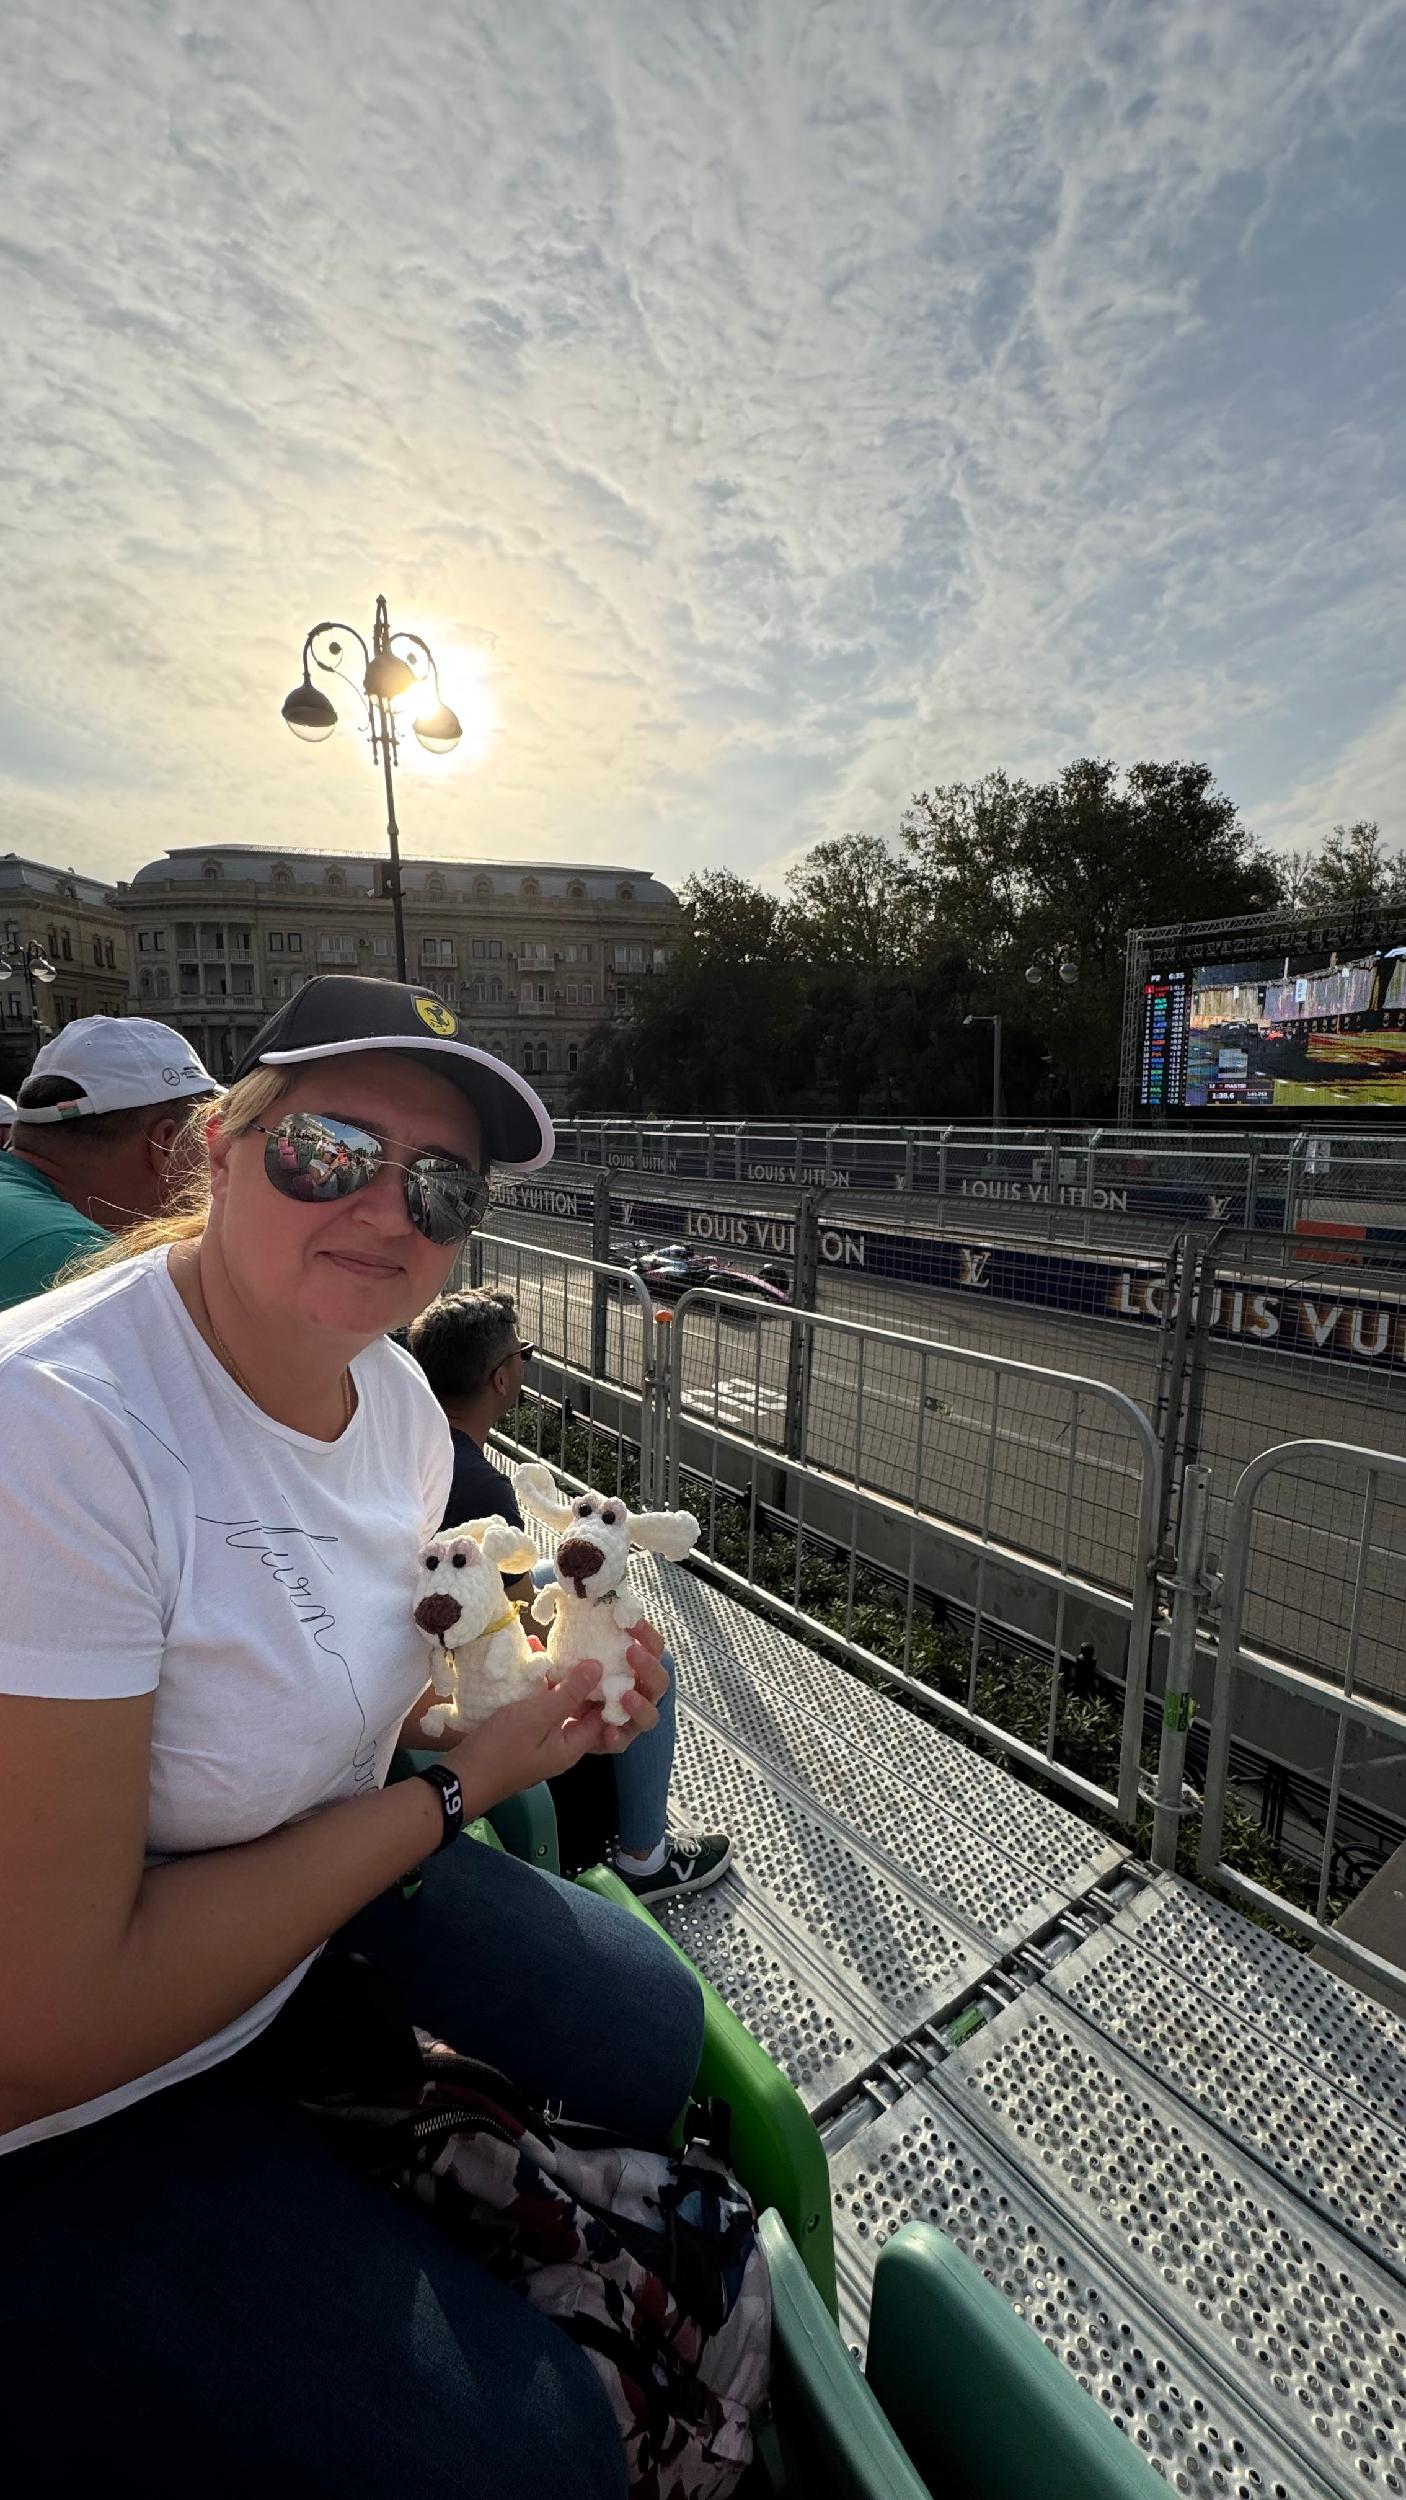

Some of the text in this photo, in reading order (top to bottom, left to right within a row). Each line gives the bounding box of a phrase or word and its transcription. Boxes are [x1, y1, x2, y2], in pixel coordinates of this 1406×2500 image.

[748, 1164, 786, 1182] LOUIS
[521, 1188, 578, 1216] VUITTON
[962, 1179, 1021, 1201] LOUIS
[688, 1211, 865, 1267] LOUIS VUION
[443, 1780, 462, 1815] 19
